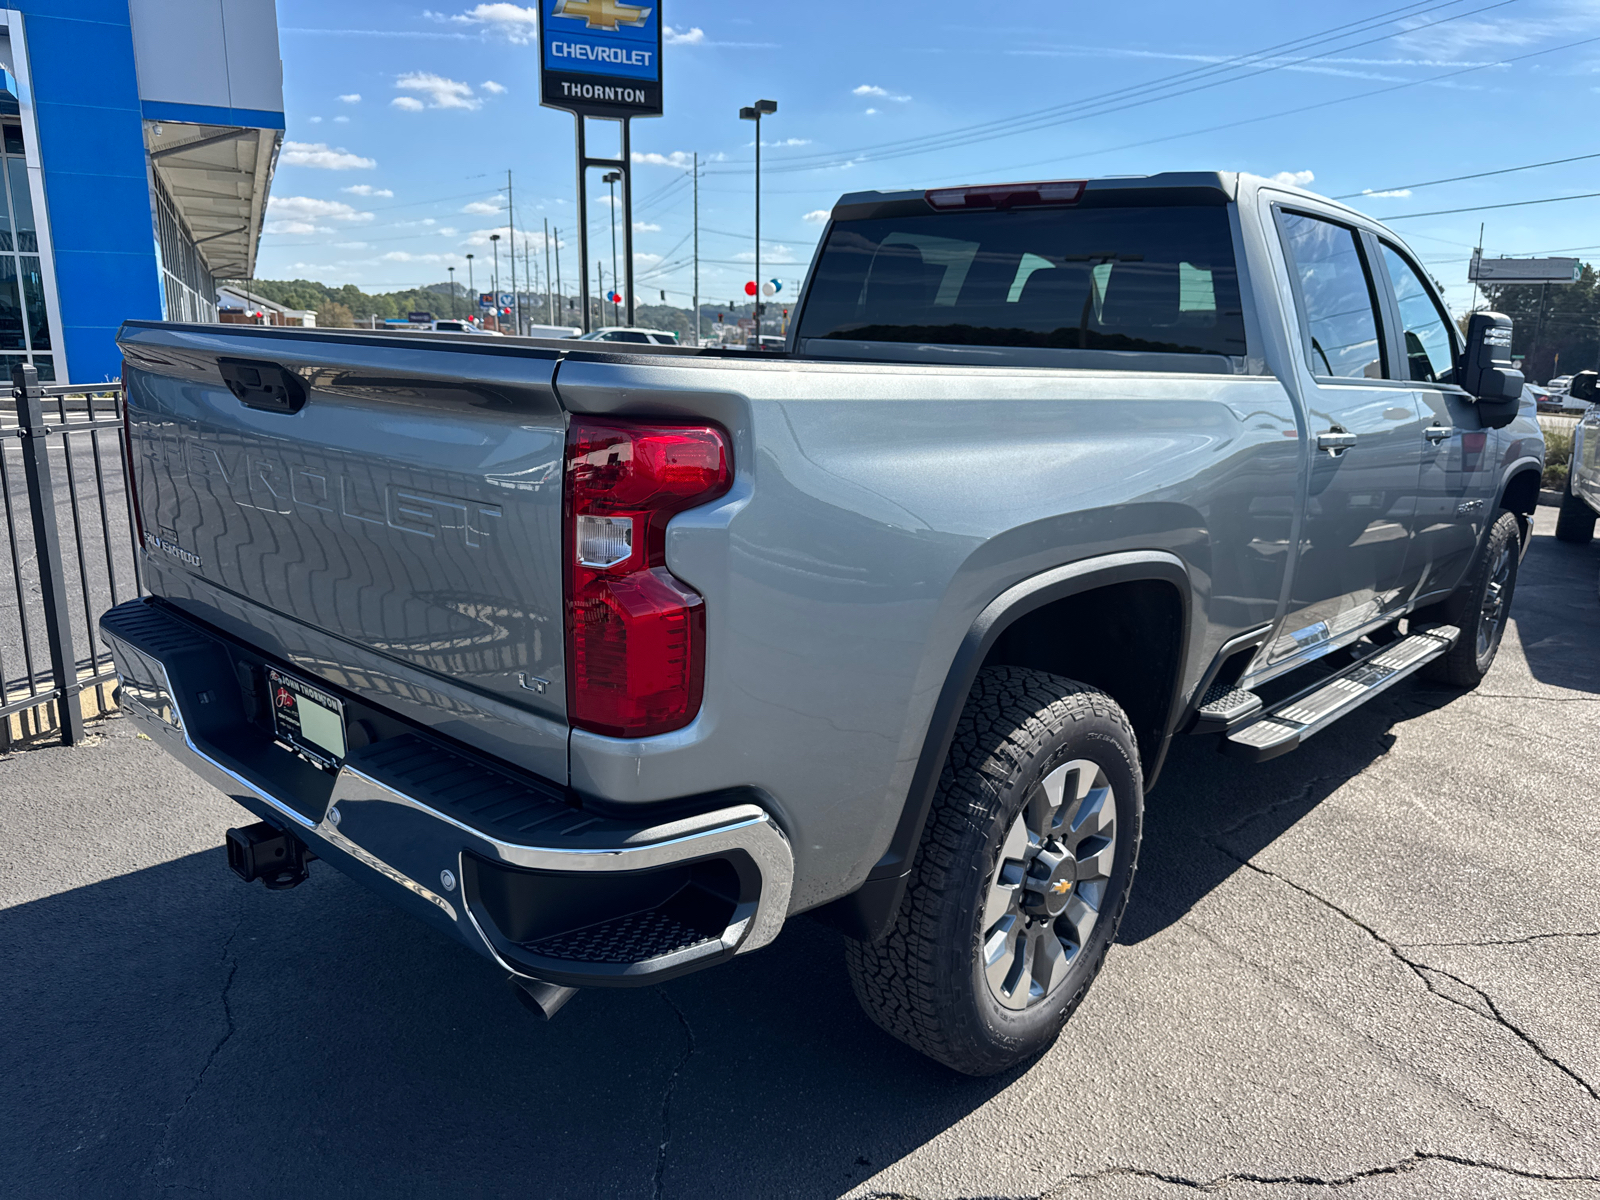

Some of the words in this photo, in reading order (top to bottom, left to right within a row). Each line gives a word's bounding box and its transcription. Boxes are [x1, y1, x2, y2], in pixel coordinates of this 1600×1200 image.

[551, 41, 652, 66] CHEVROLET
[561, 82, 645, 103] THORNTON
[144, 530, 202, 567] SILVERADO
[282, 675, 300, 691] JOHN
[518, 672, 550, 694] LT
